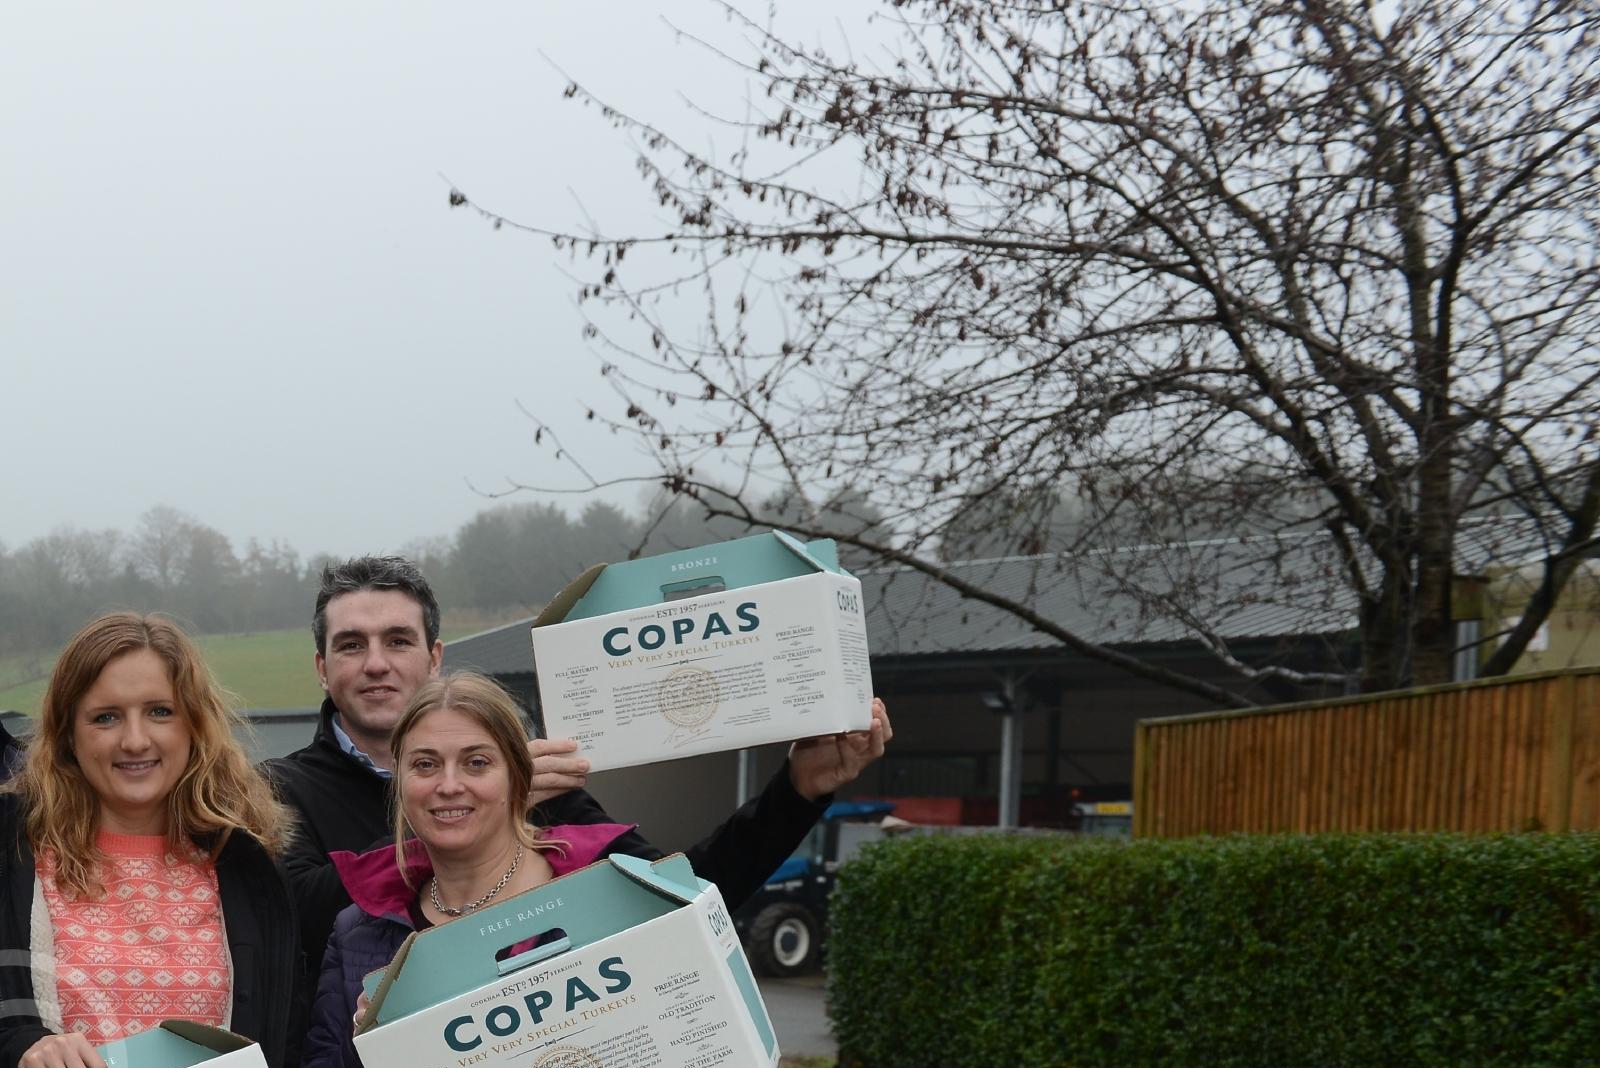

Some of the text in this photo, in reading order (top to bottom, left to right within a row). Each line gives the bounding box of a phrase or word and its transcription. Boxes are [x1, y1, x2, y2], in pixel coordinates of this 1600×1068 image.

[679, 603, 697, 614] 1957
[602, 602, 760, 656] COPAS
[480, 898, 564, 936] FREE RANGE
[528, 970, 549, 986] 1957
[654, 971, 699, 992] FREE RANGE
[444, 956, 632, 1052] COPAS
[658, 995, 716, 1020] OLD TRADITION
[670, 1021, 727, 1046] HAND FINISHED
[696, 1056, 712, 1066] THE
[712, 1049, 733, 1060] FARM
